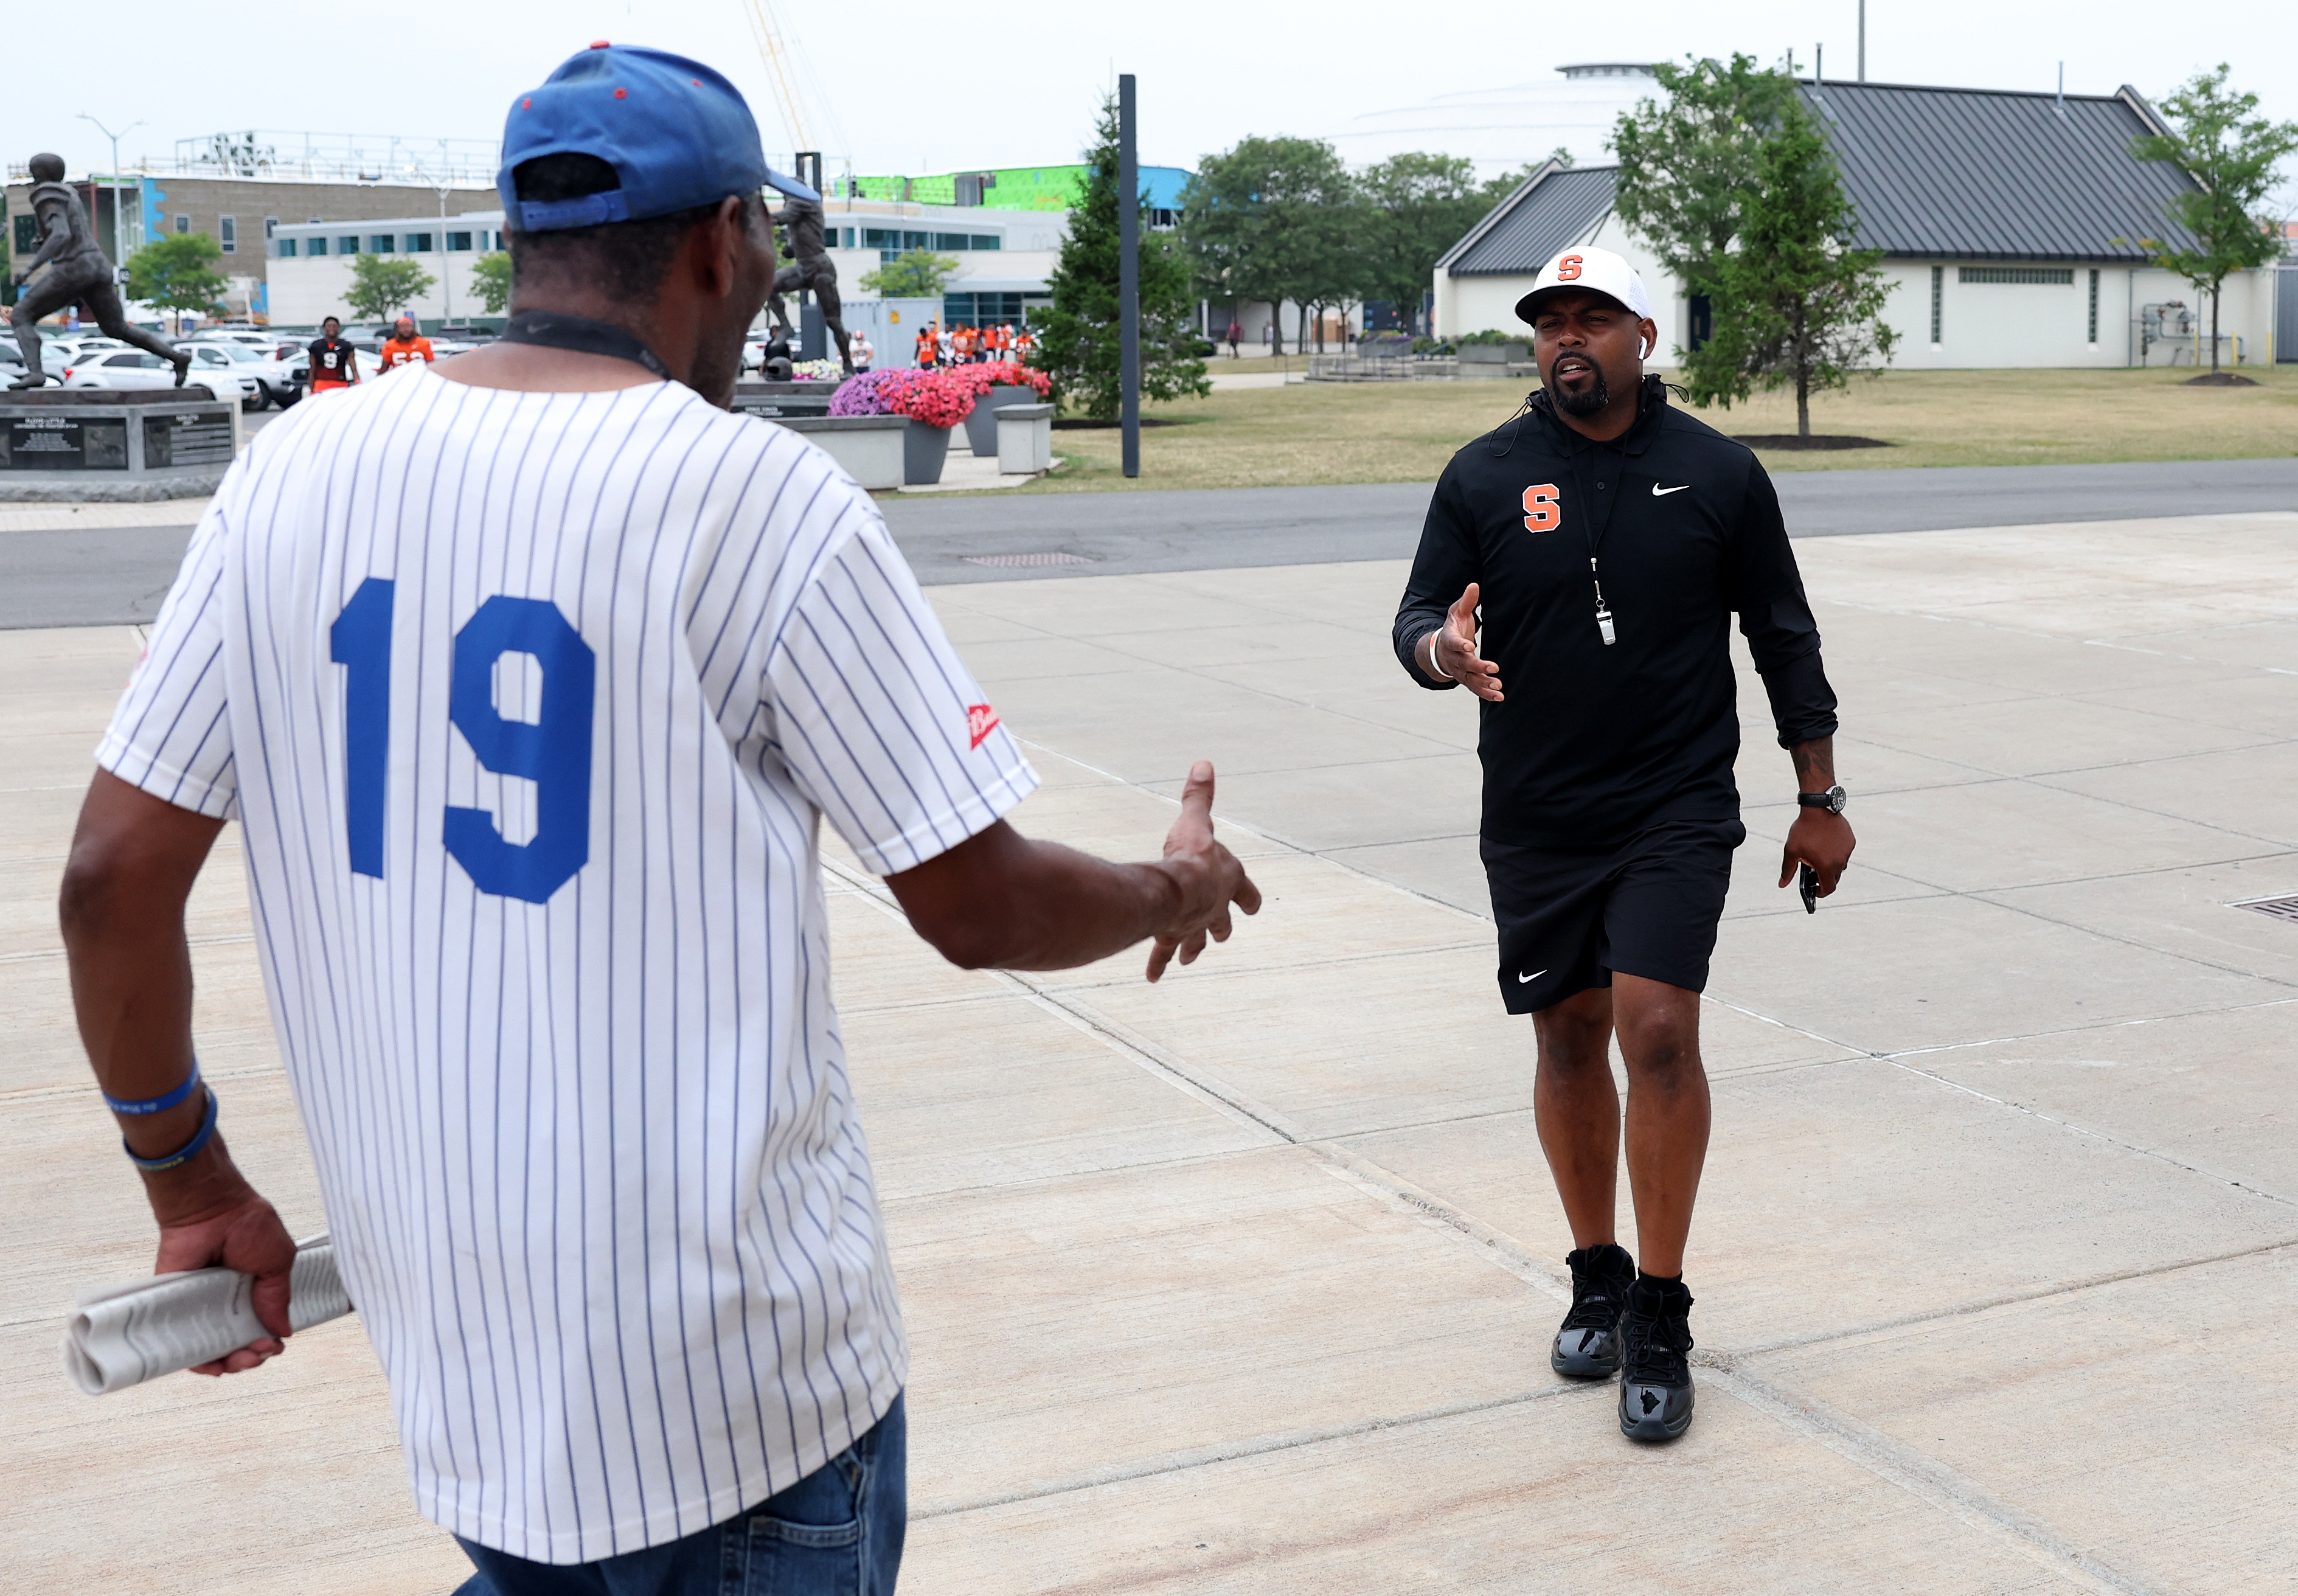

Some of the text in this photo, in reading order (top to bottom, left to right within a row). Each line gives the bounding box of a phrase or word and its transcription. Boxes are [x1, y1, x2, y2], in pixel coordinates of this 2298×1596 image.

[1558, 255, 1583, 282] S
[324, 352, 338, 369] 9
[1522, 483, 1561, 533] S
[330, 577, 595, 905] 19
